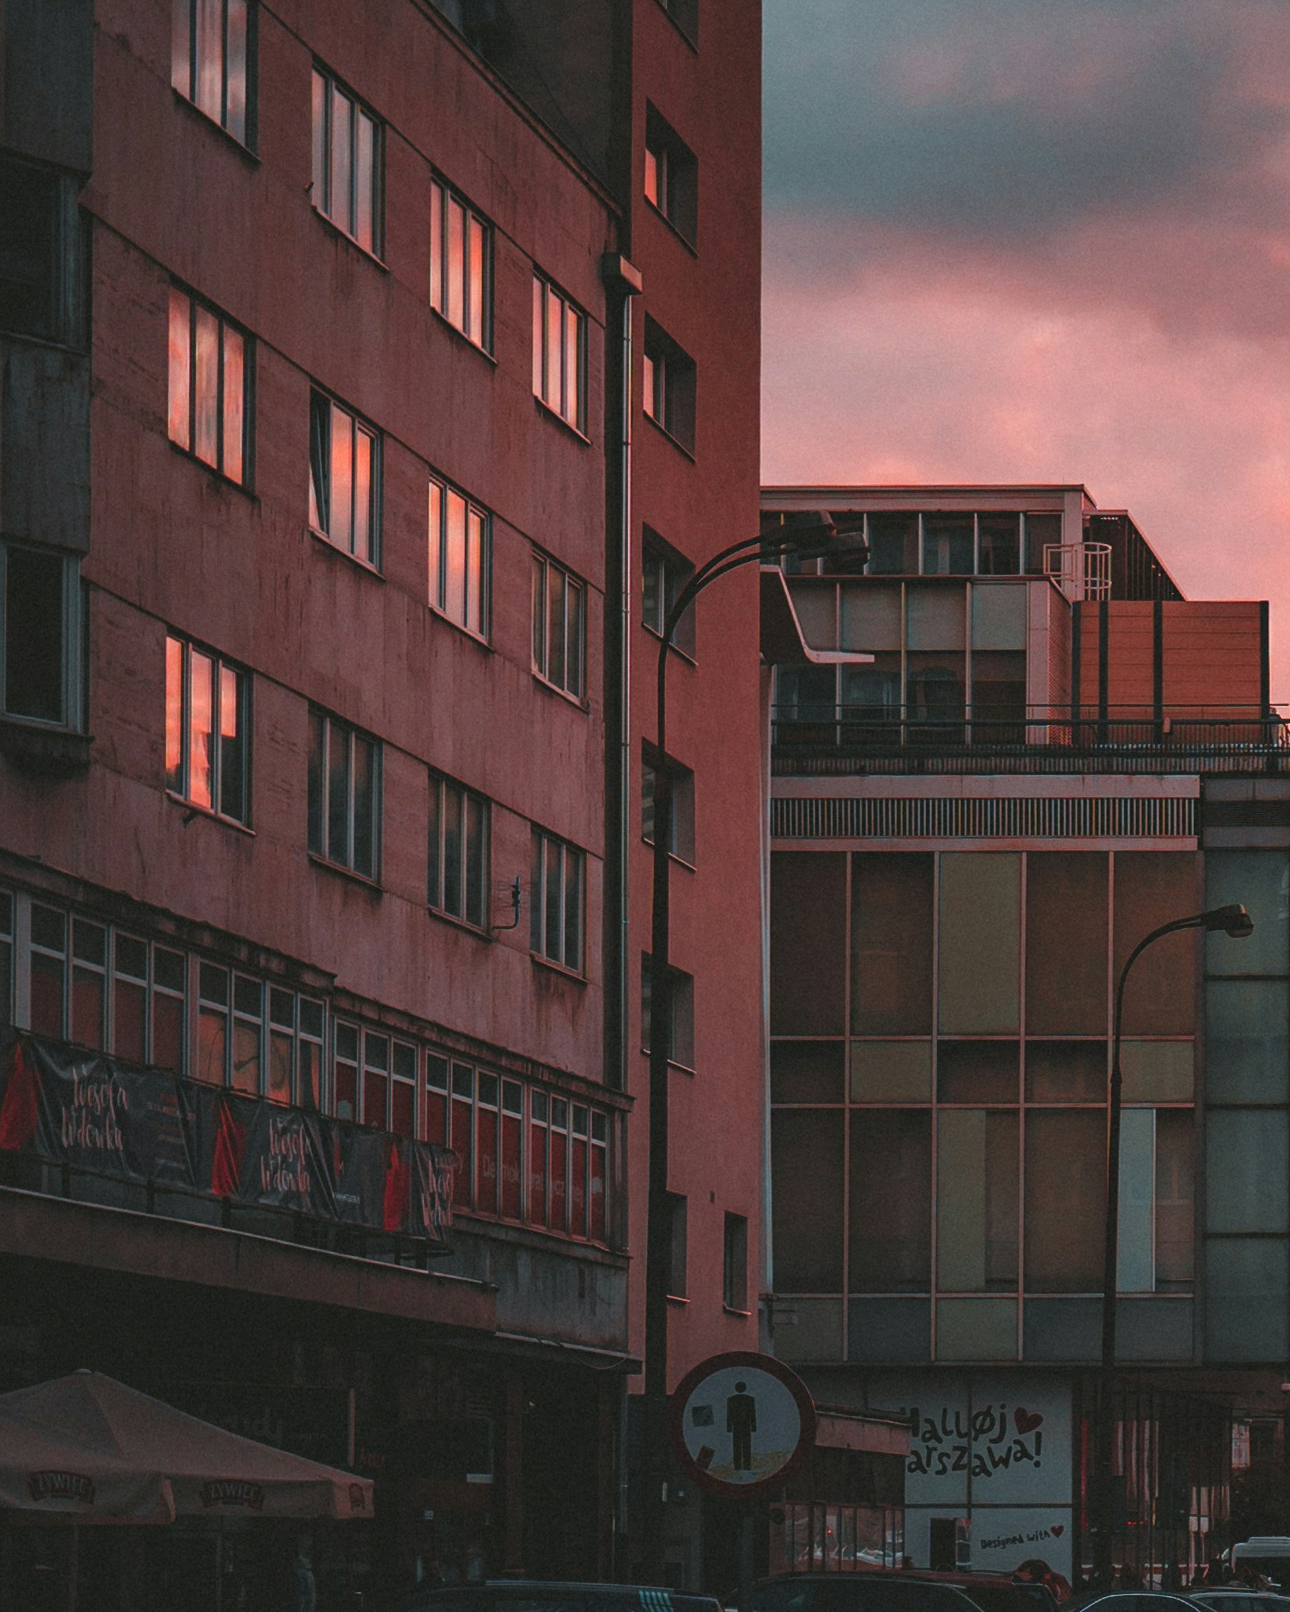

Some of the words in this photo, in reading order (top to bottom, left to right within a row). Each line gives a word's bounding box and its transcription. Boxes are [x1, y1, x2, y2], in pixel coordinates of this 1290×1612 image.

[907, 1431, 1043, 1478] arszawa!
[980, 1534, 1024, 1550] Designed
[1026, 1530, 1051, 1542] with
